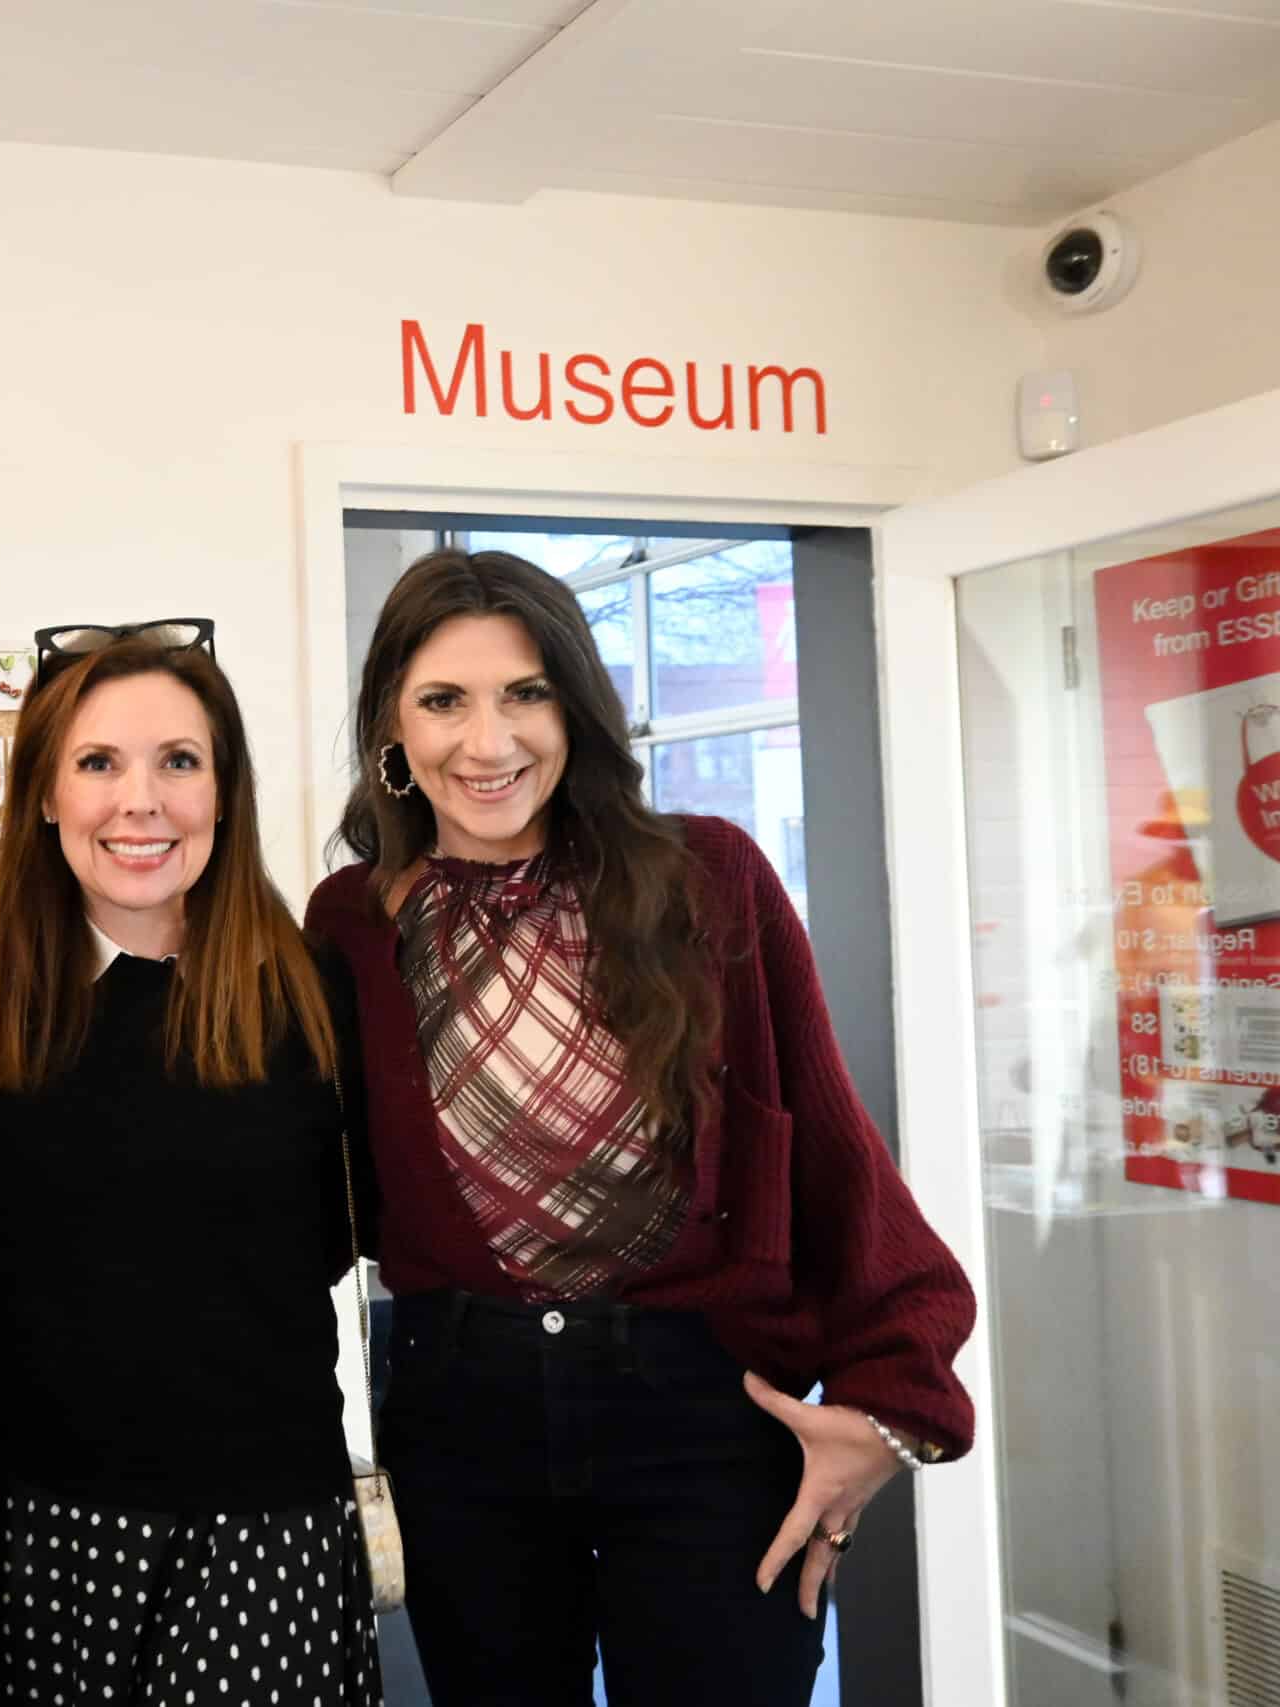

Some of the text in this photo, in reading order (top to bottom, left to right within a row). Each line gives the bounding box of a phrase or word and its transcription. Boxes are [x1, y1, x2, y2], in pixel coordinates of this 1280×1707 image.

[401, 319, 827, 435] Museum
[1133, 594, 1196, 623] Keep
[1202, 586, 1230, 609] or
[1153, 629, 1211, 656] from
